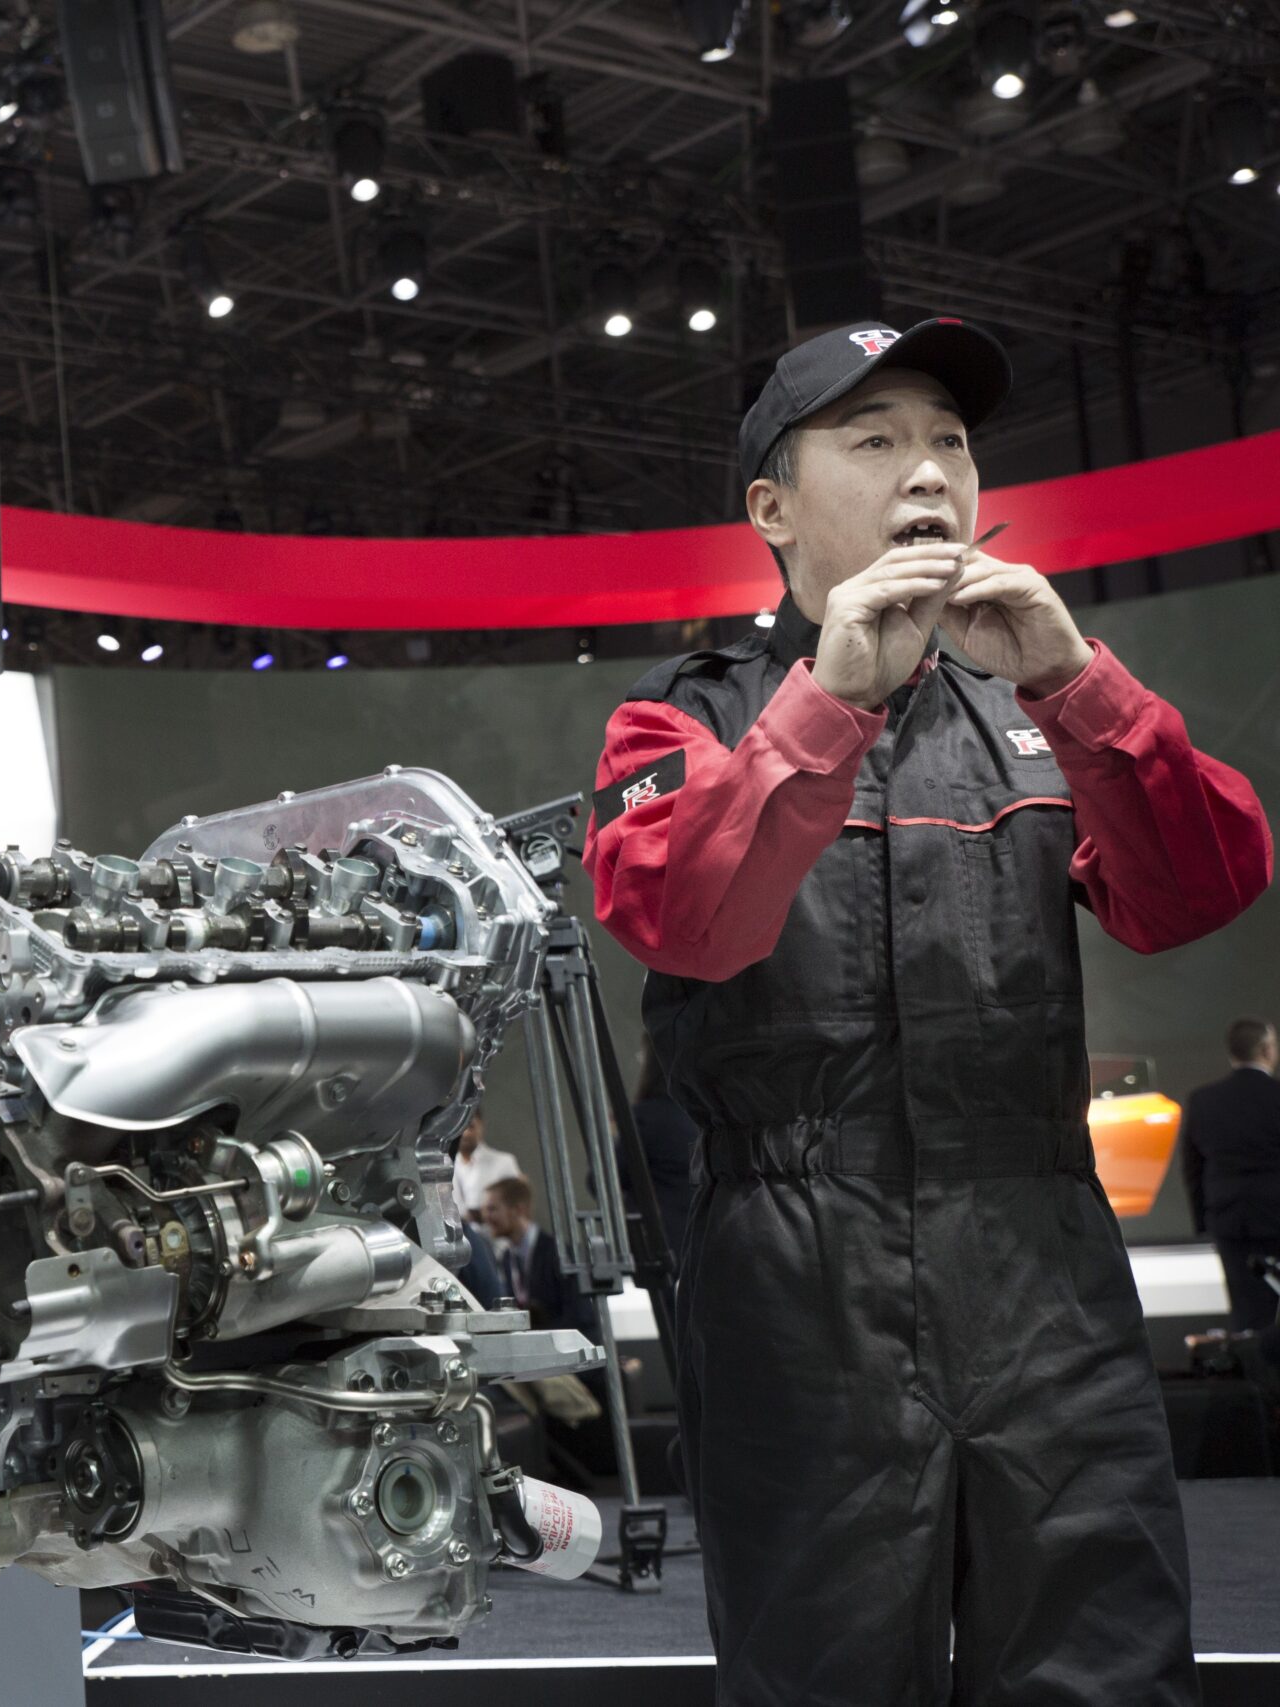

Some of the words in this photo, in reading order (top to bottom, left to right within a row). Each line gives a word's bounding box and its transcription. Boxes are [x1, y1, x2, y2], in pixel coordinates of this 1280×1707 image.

[622, 772, 658, 799] GT
[624, 783, 661, 813] R
[561, 1506, 573, 1550] NISSAN
